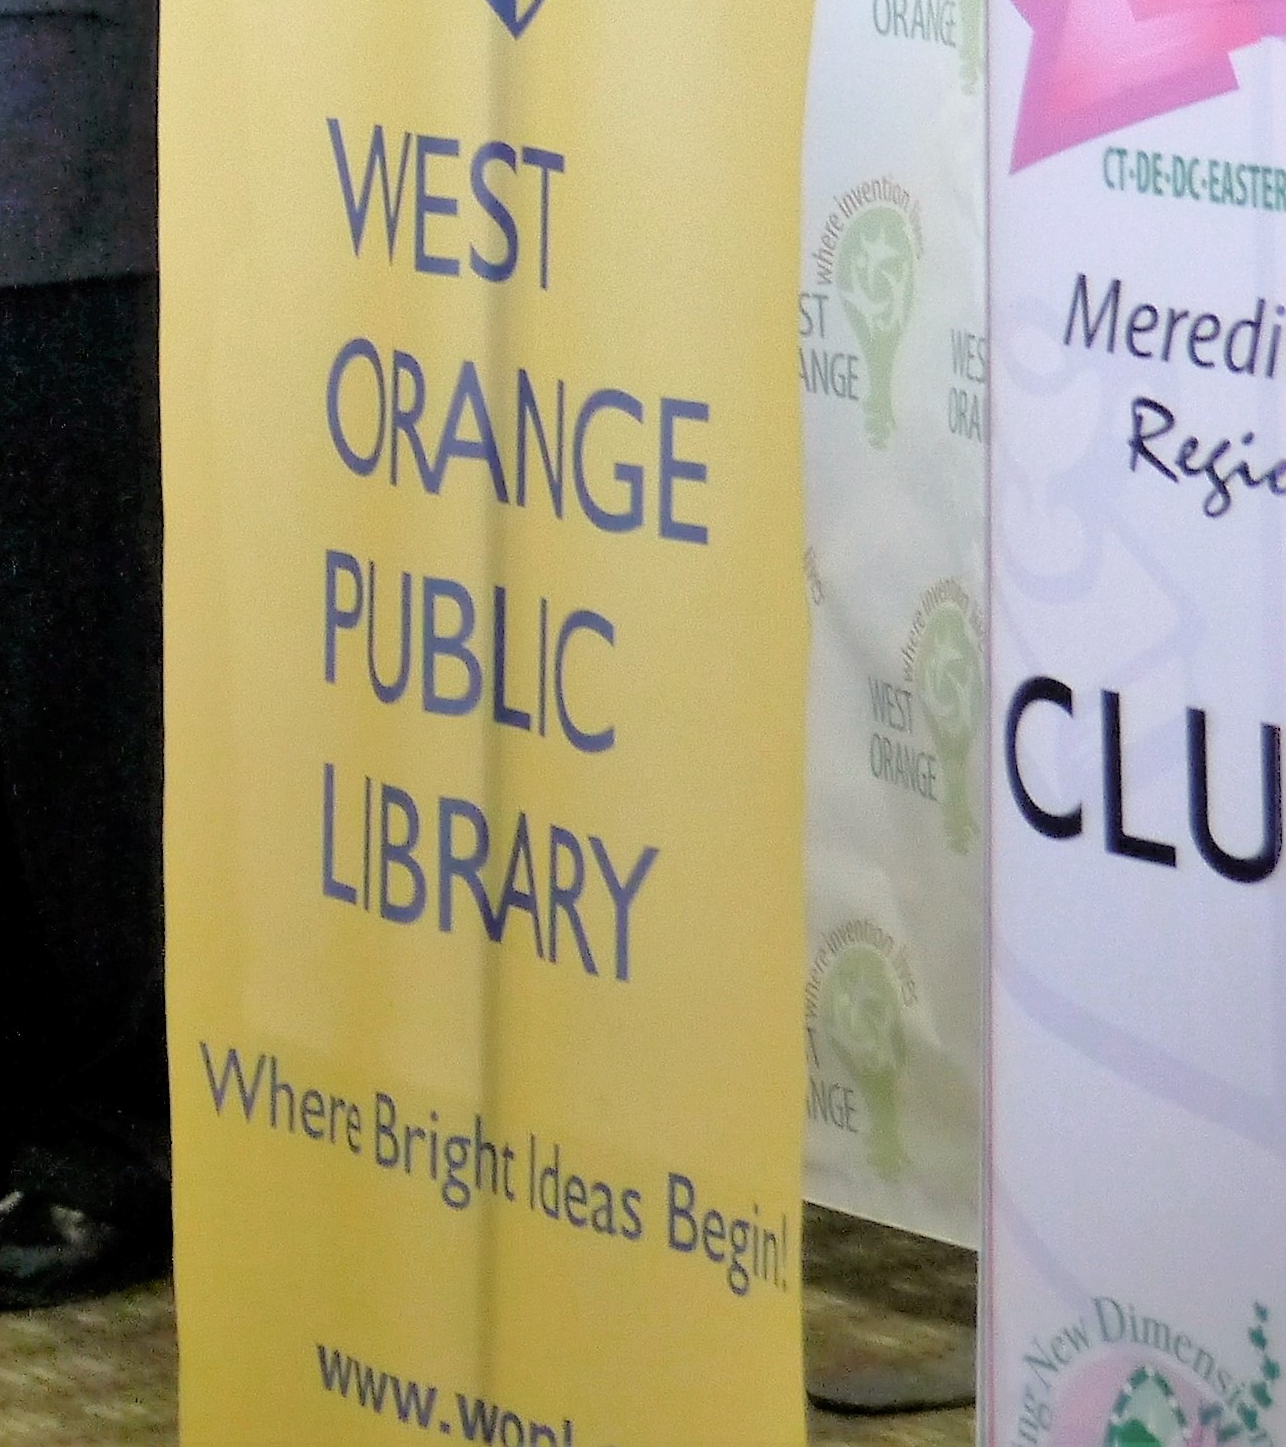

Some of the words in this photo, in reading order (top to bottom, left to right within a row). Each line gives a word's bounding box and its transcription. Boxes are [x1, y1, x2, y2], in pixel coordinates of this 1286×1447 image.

[324, 116, 567, 291] WEST
[812, 212, 846, 286] where
[833, 175, 912, 218] invention
[324, 337, 711, 547] ORANGE
[323, 548, 616, 754] PUBLIC
[867, 675, 913, 735] WEST
[869, 732, 940, 805] ORANGE
[321, 760, 661, 984] LIBRARY
[198, 1040, 363, 1155] Where
[374, 1091, 516, 1212] Bright
[528, 1131, 644, 1242] Ideas
[667, 1171, 790, 1297] Begin!
[1022, 1317, 1090, 1390] New
